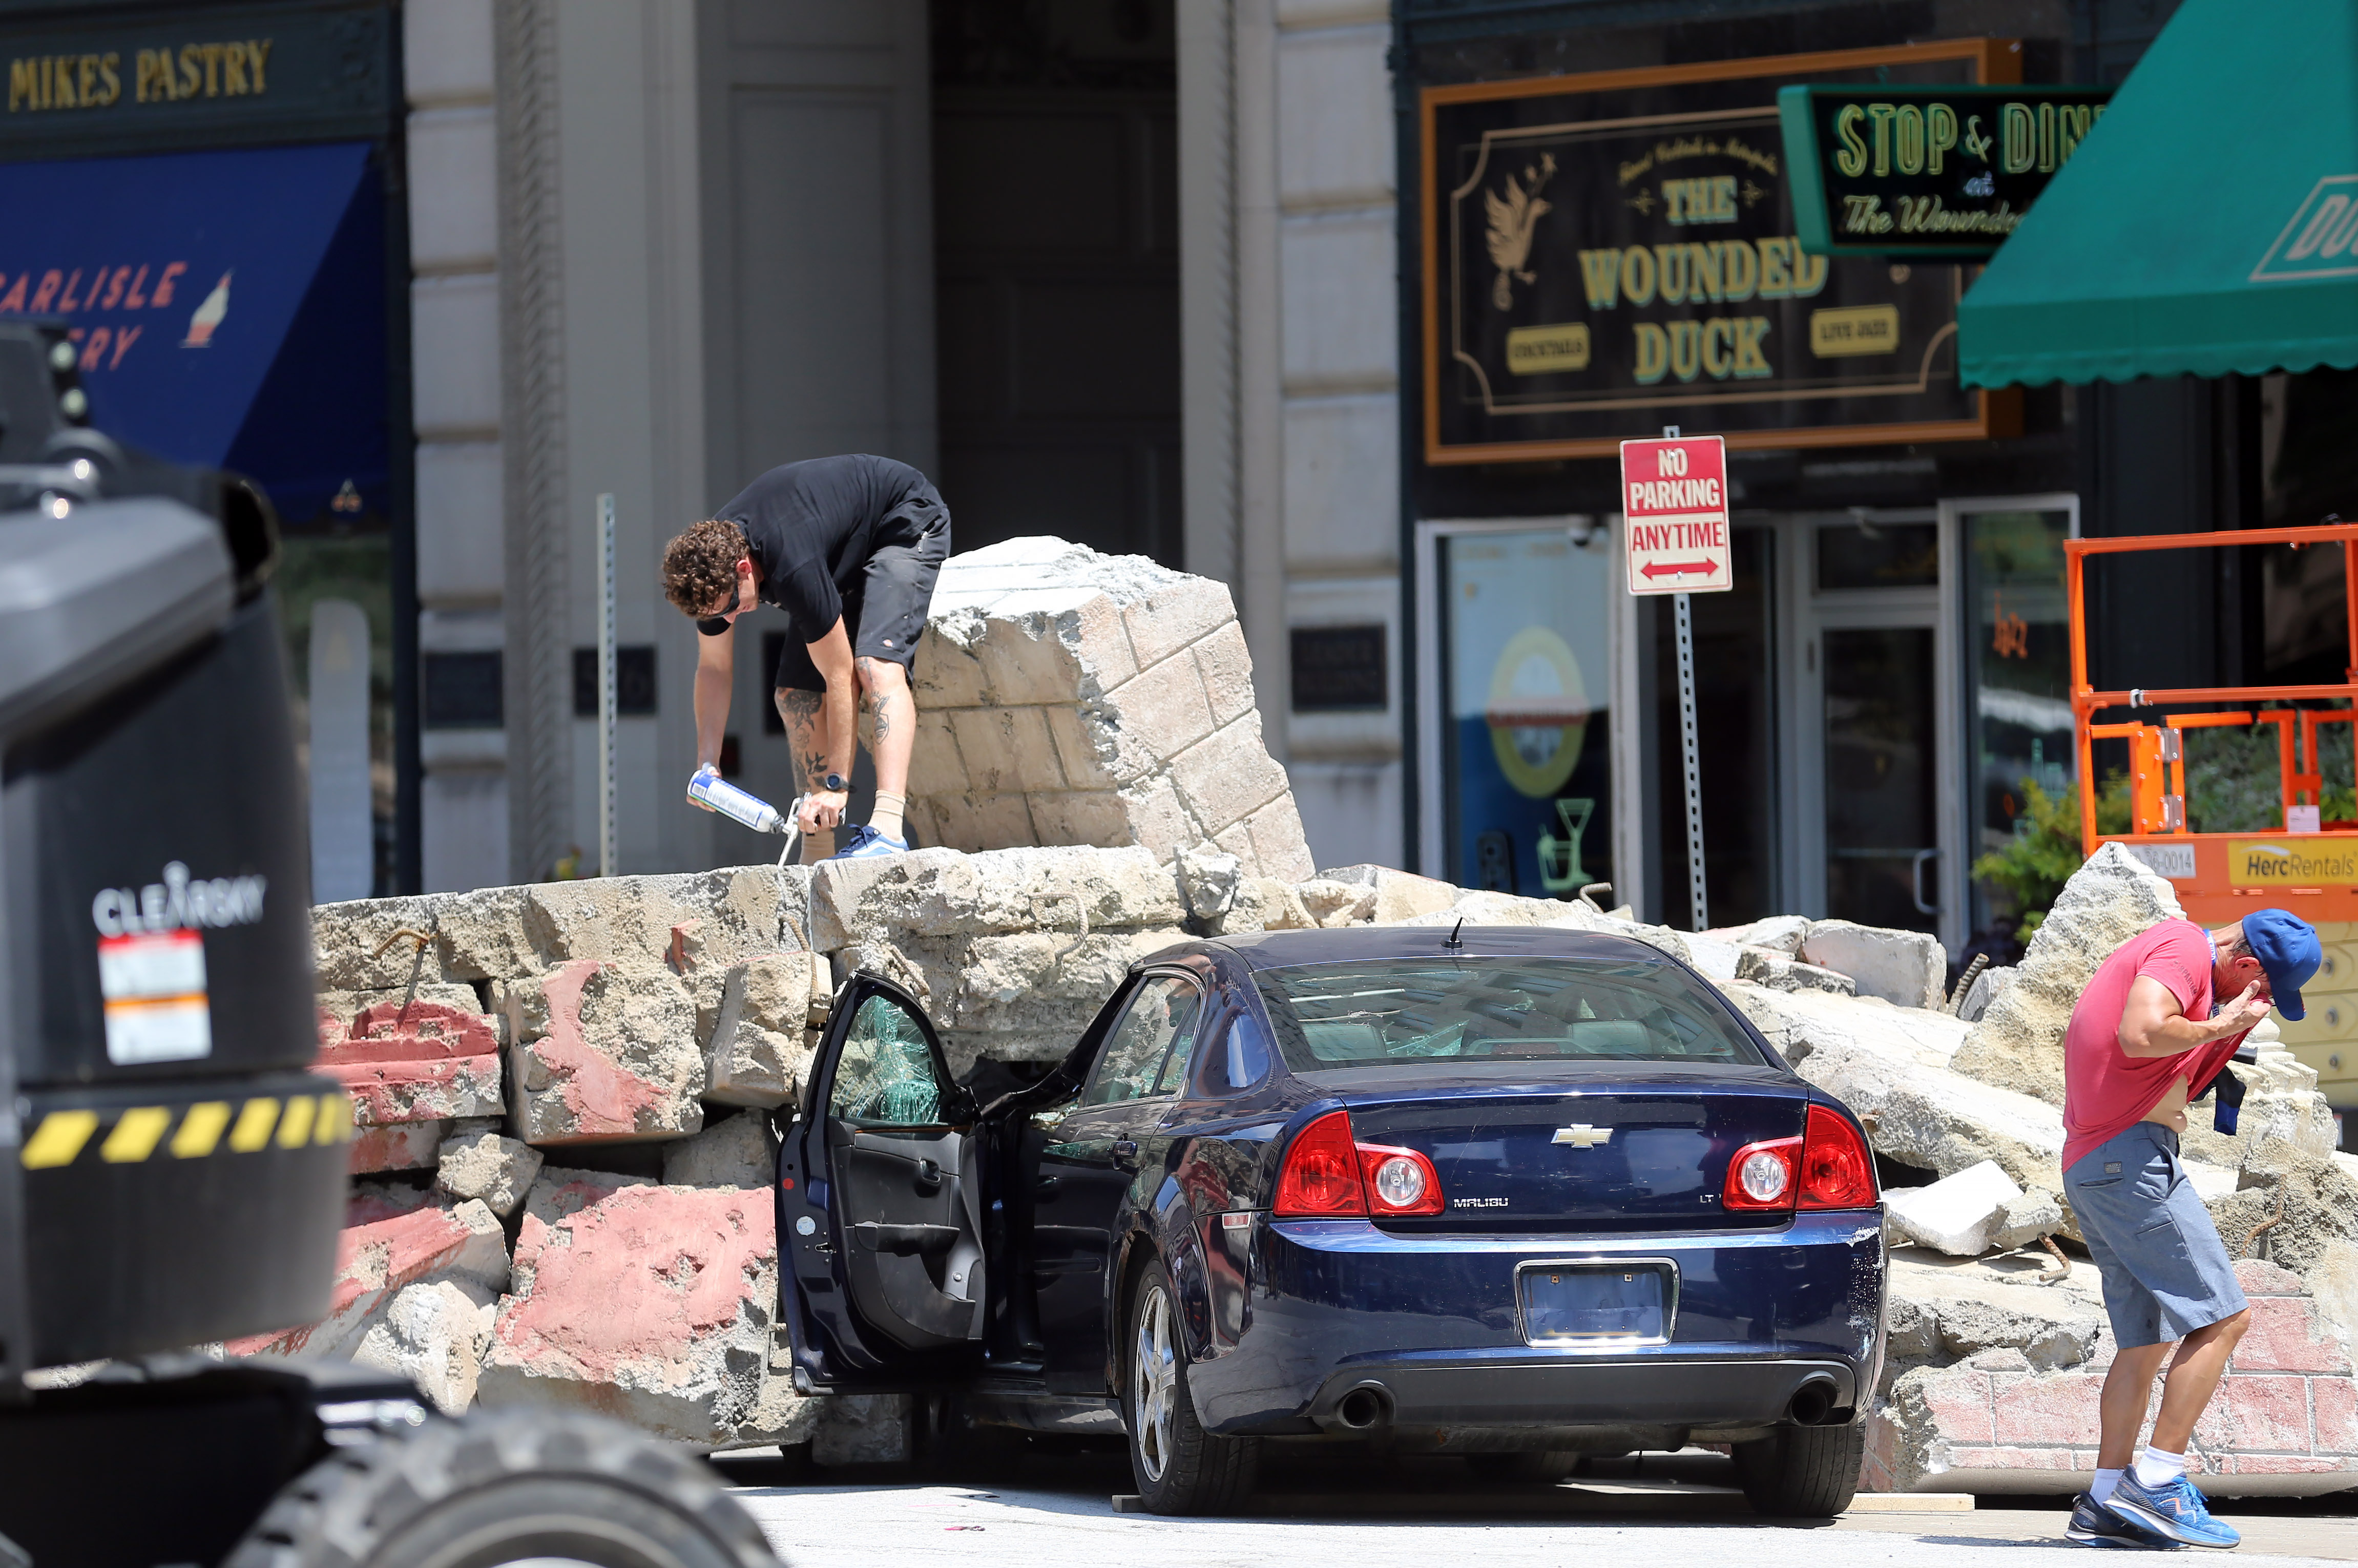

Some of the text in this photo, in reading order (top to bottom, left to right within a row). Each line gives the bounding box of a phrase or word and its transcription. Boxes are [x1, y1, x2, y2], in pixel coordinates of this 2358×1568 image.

[9, 38, 273, 112] MIKES PASTRY
[1837, 102, 1958, 177] STOP
[1965, 115, 1992, 162] &
[2004, 102, 2107, 174] DIN
[1661, 175, 1738, 226] THE
[1963, 171, 1995, 197] at
[1844, 195, 1894, 234] The
[0, 261, 188, 314] ARLISLE
[1579, 236, 1828, 308] WOUNDED
[1633, 316, 1772, 384] DUCK
[1658, 448, 1688, 477] NO
[1630, 478, 1720, 510] PARKING
[1632, 521, 1725, 551] ANYTIME
[1454, 1195, 1715, 1208] MALIBU LT
